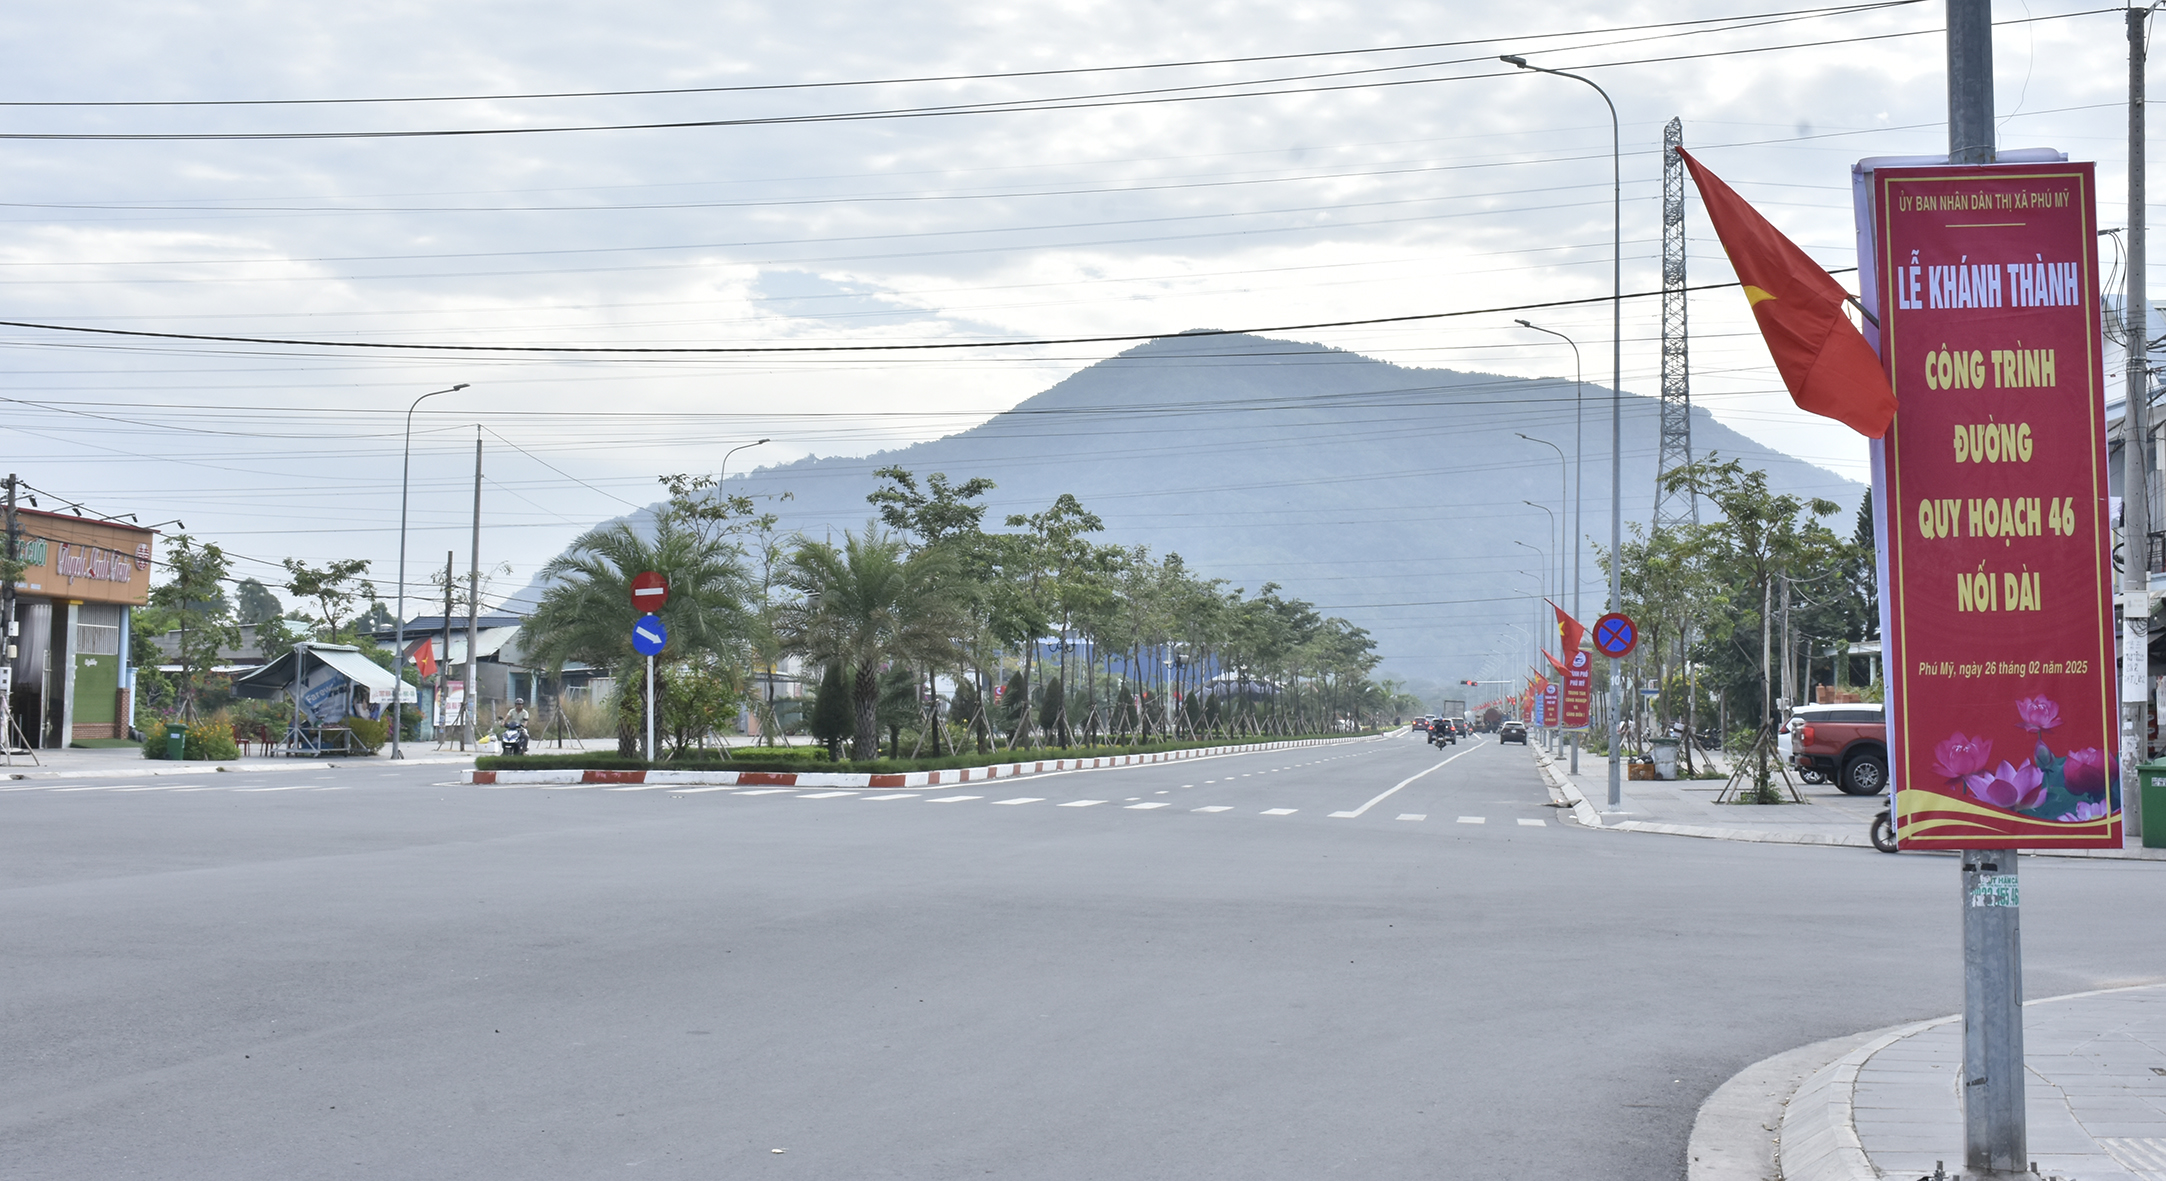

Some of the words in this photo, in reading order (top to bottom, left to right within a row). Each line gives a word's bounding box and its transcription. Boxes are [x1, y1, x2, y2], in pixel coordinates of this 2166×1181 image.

[1899, 190, 1912, 212] ỦY
[1915, 196, 1937, 212] BAN
[1940, 191, 1969, 211] NHÂN
[1971, 190, 1993, 210] DÂN
[1995, 193, 2012, 213] THỊ
[2014, 189, 2029, 209] XÃ
[2030, 188, 2052, 208] PHÚ
[2054, 187, 2070, 208] MỸ
[1897, 248, 1923, 310] LỄ
[1928, 254, 2003, 309] KHÁNH
[2006, 253, 2079, 307] THÀNH
[1925, 342, 1986, 390] CÔNG
[1990, 339, 2056, 388] TRÌNH
[1953, 414, 2033, 463] ĐƯỜNG
[1918, 498, 1962, 540] QUY
[1967, 497, 2042, 547] HOẠCH
[2048, 496, 2076, 537] 46
[1957, 558, 1998, 613] NỐI
[2003, 562, 2042, 612] DÀI
[1610, 675, 1621, 686] 10
[1918, 661, 1938, 676] Phú
[1939, 661, 1957, 678] Mỹ,
[1959, 660, 1983, 678] ngày
[1985, 661, 1997, 675] 26
[1999, 660, 2026, 678] tháng
[2028, 660, 2040, 674] 02
[2042, 660, 2063, 674] năm
[2065, 660, 2088, 674] 2025
